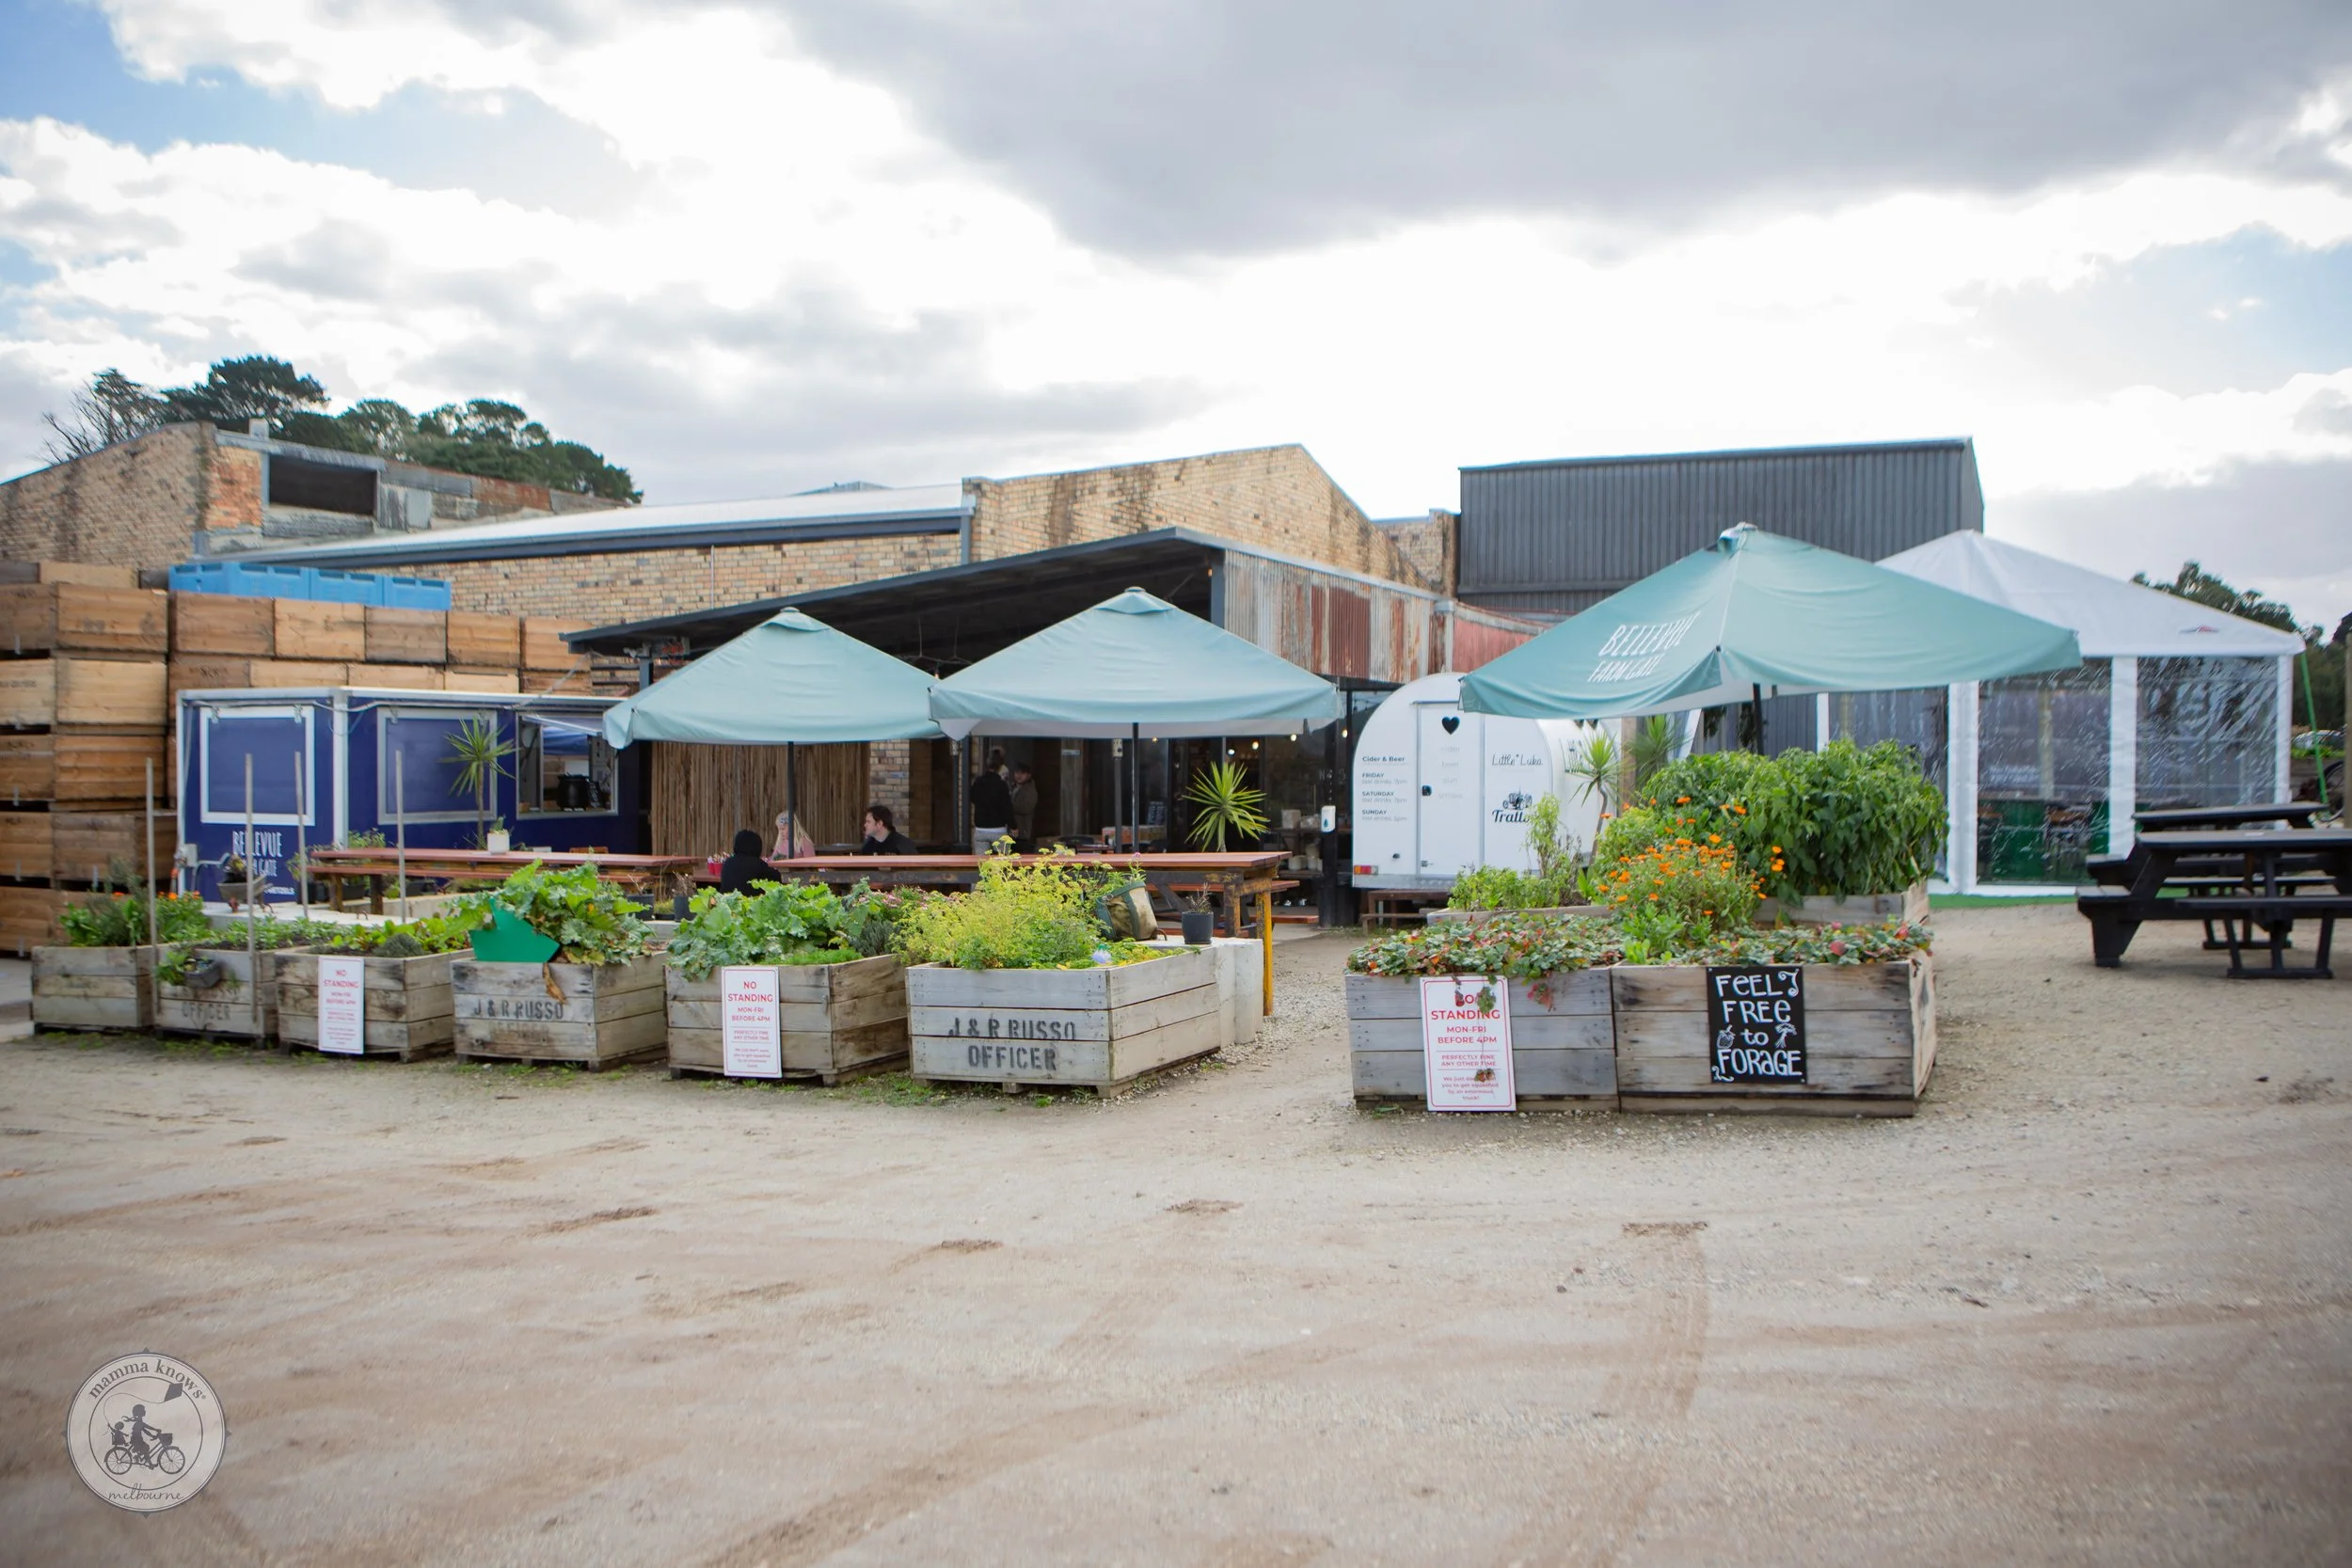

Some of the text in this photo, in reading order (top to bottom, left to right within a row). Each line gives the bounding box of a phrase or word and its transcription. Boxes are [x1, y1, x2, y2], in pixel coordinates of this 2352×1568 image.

[1598, 612, 1700, 657] BELLEVUE
[1587, 659, 1634, 682] FARM
[743, 981, 756, 990] NO
[727, 993, 773, 1003] STANDING
[474, 999, 564, 1020] J & R RUSSO
[1431, 1009, 1501, 1021] STANDING
[948, 1017, 1076, 1039] J & R RUSSO
[1740, 1028, 1769, 1045] to
[968, 1045, 1057, 1070] OFFICER
